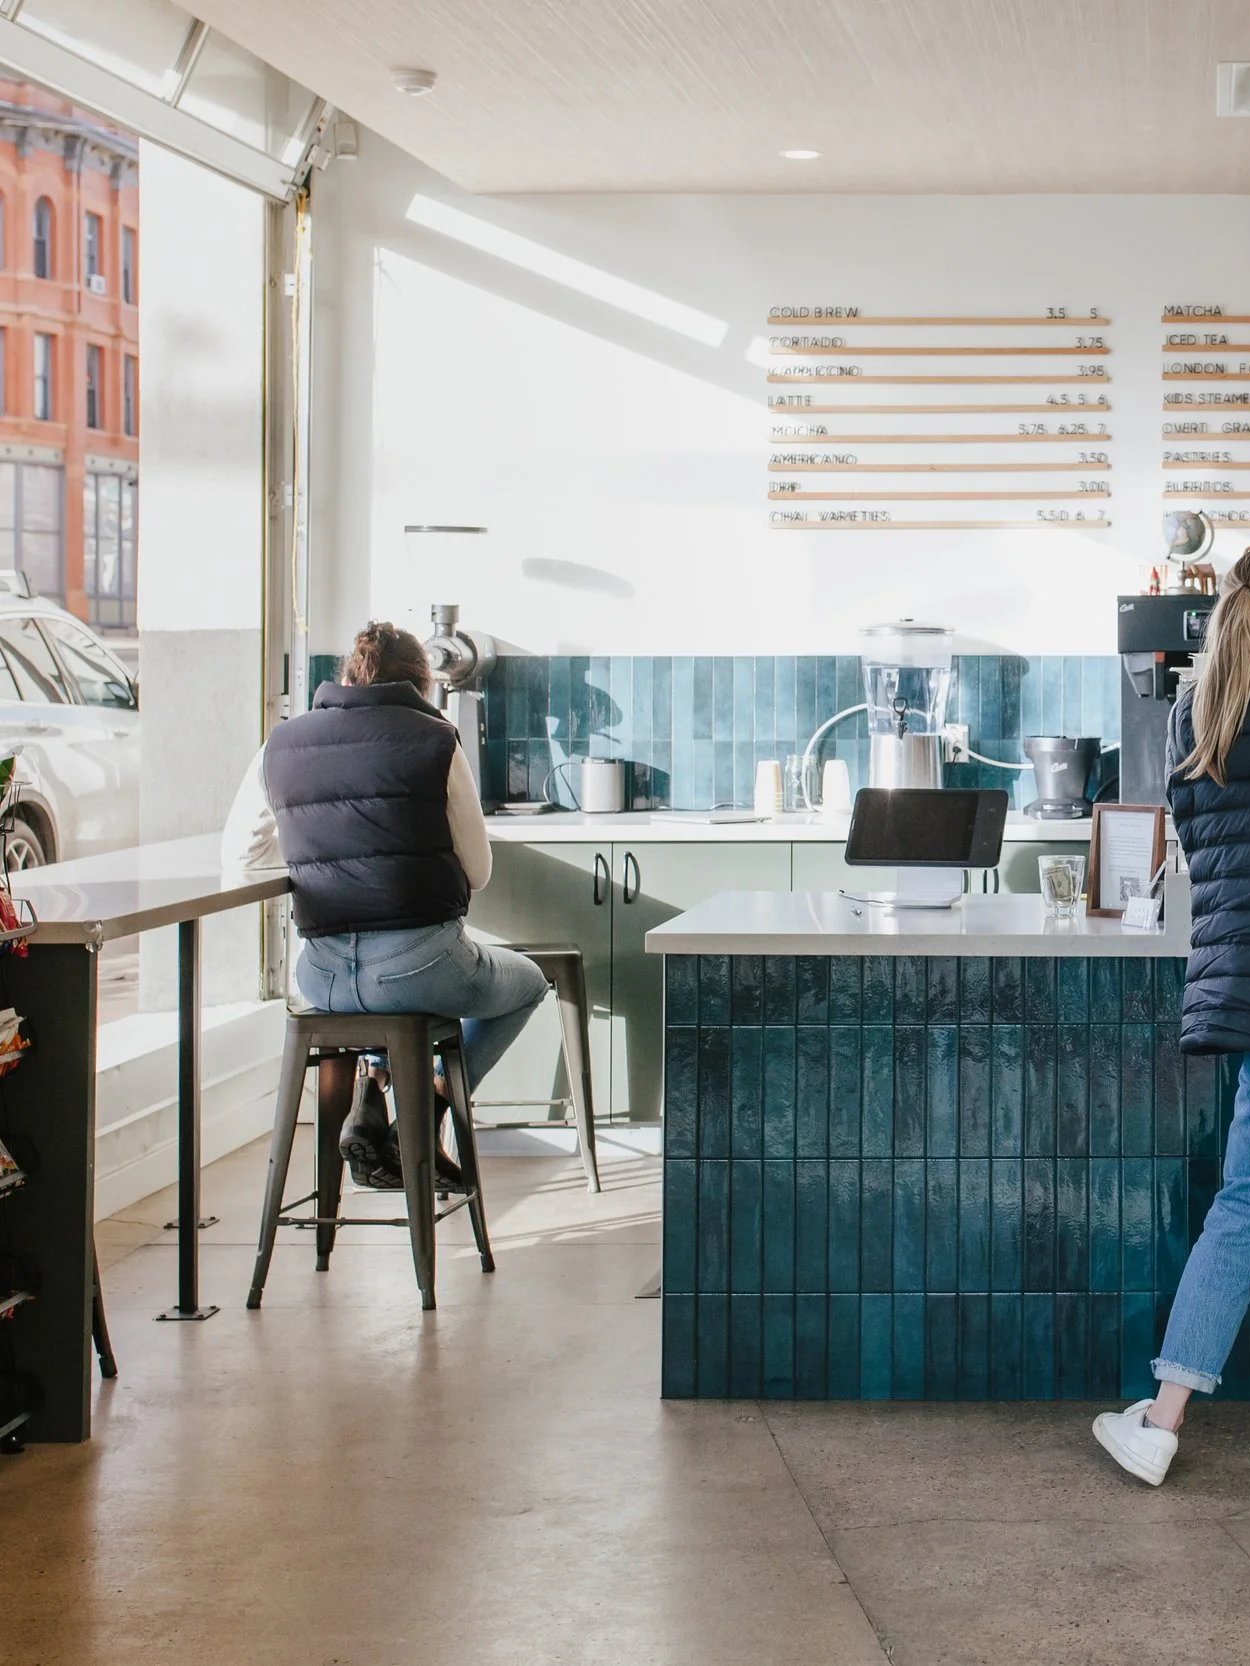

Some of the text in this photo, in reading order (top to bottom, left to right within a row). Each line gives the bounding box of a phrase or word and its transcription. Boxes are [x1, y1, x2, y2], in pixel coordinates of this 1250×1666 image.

[769, 306, 859, 318] COLD BREW
[1046, 307, 1098, 319] 3.5 5
[1163, 305, 1222, 317] MATCHA
[768, 336, 844, 348] CORTADO
[1075, 336, 1104, 348] 3.75
[1166, 334, 1228, 346] ICED TEA
[1077, 365, 1105, 376] 3.95
[1163, 363, 1225, 374] LONDON
[767, 395, 813, 407] LATTE
[1046, 394, 1068, 405] 4.5
[1163, 393, 1193, 404] KIDS
[772, 424, 829, 436] MOCHA
[1018, 424, 1106, 435] 5.75 6.25 7
[769, 453, 858, 464] AMERICANO
[1078, 452, 1108, 463] 3.50
[1163, 451, 1233, 463] PASTRIES
[818, 511, 891, 522] VARIETIES
